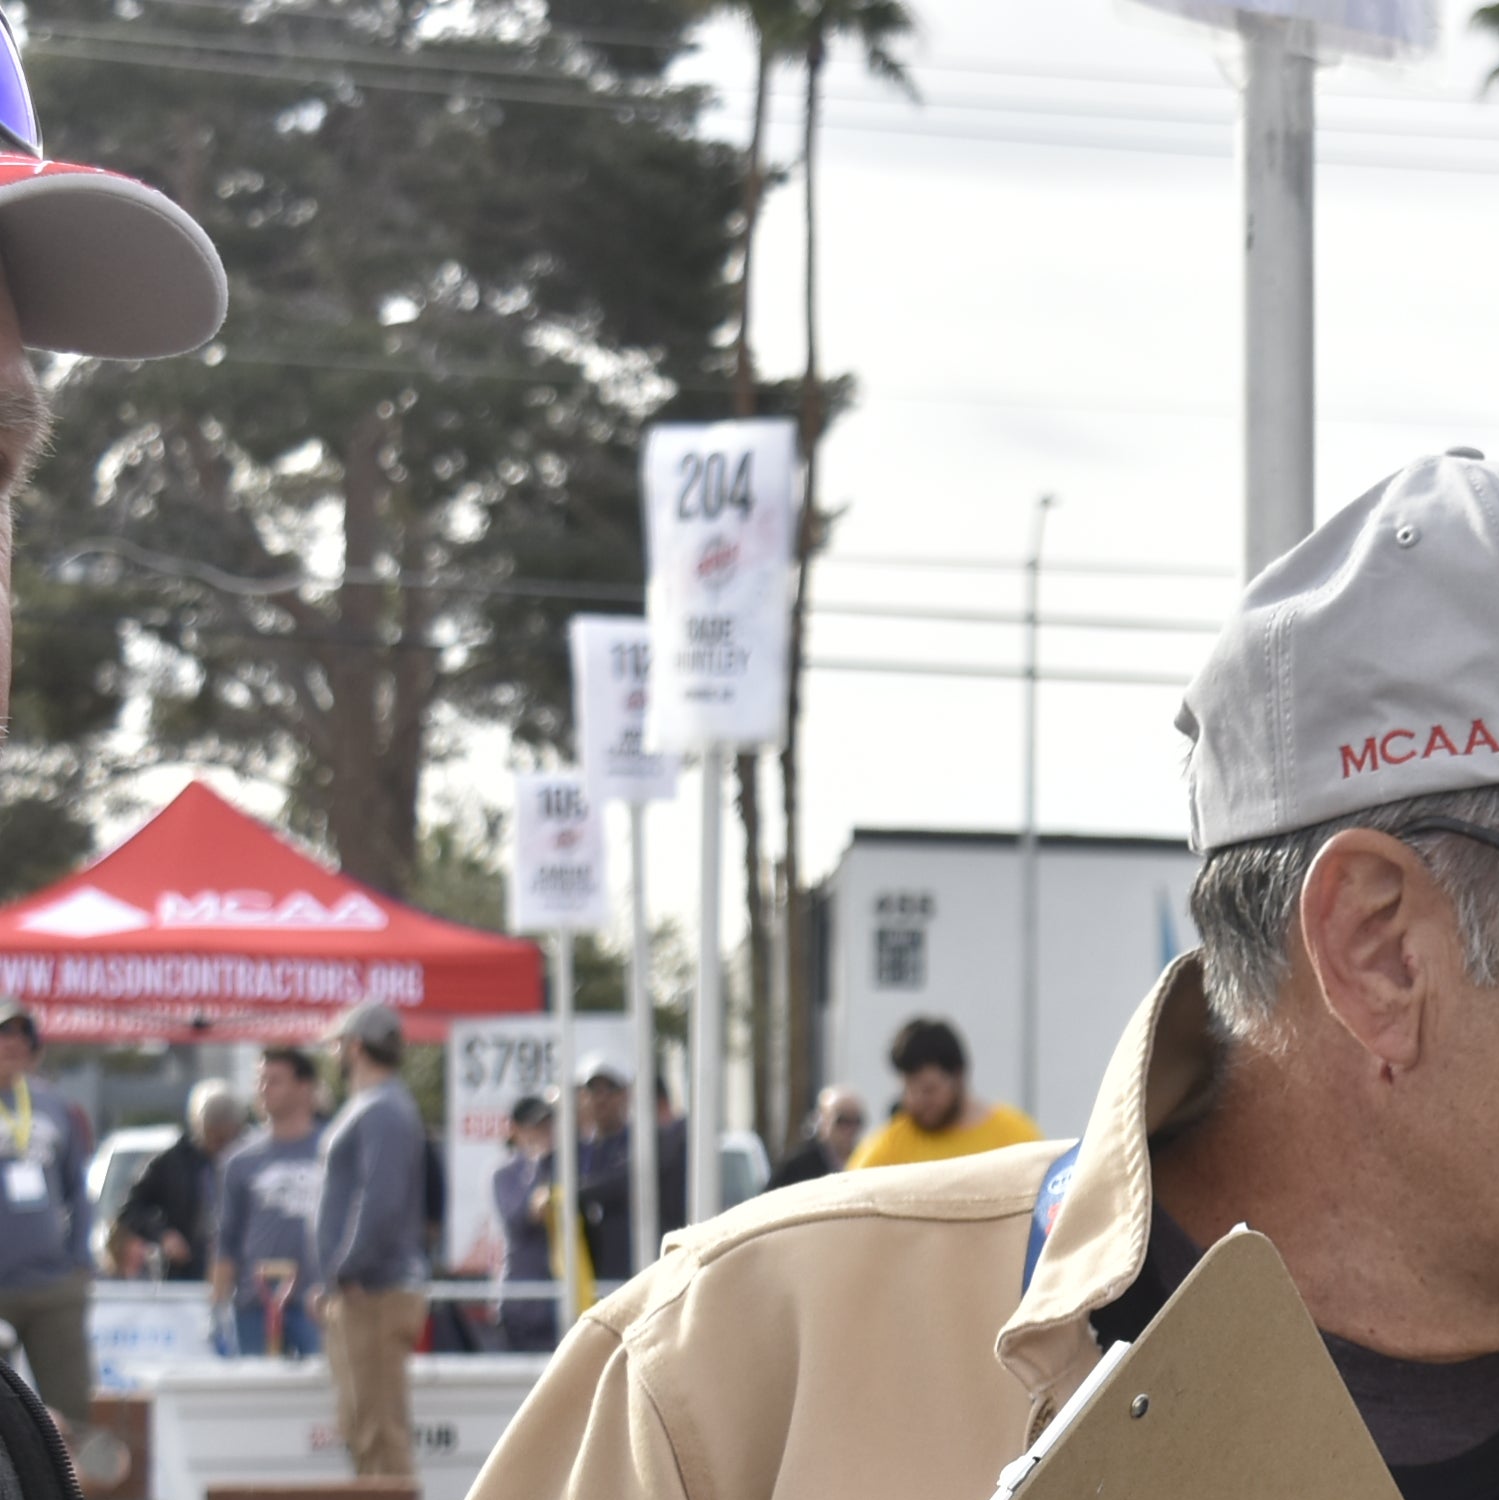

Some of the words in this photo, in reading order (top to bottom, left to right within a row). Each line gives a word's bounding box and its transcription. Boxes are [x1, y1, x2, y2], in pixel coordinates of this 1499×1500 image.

[677, 449, 754, 521] 204
[157, 889, 388, 930] MCAA
[0, 950, 424, 1005] WW.MASONCONTRACTORS.ORG
